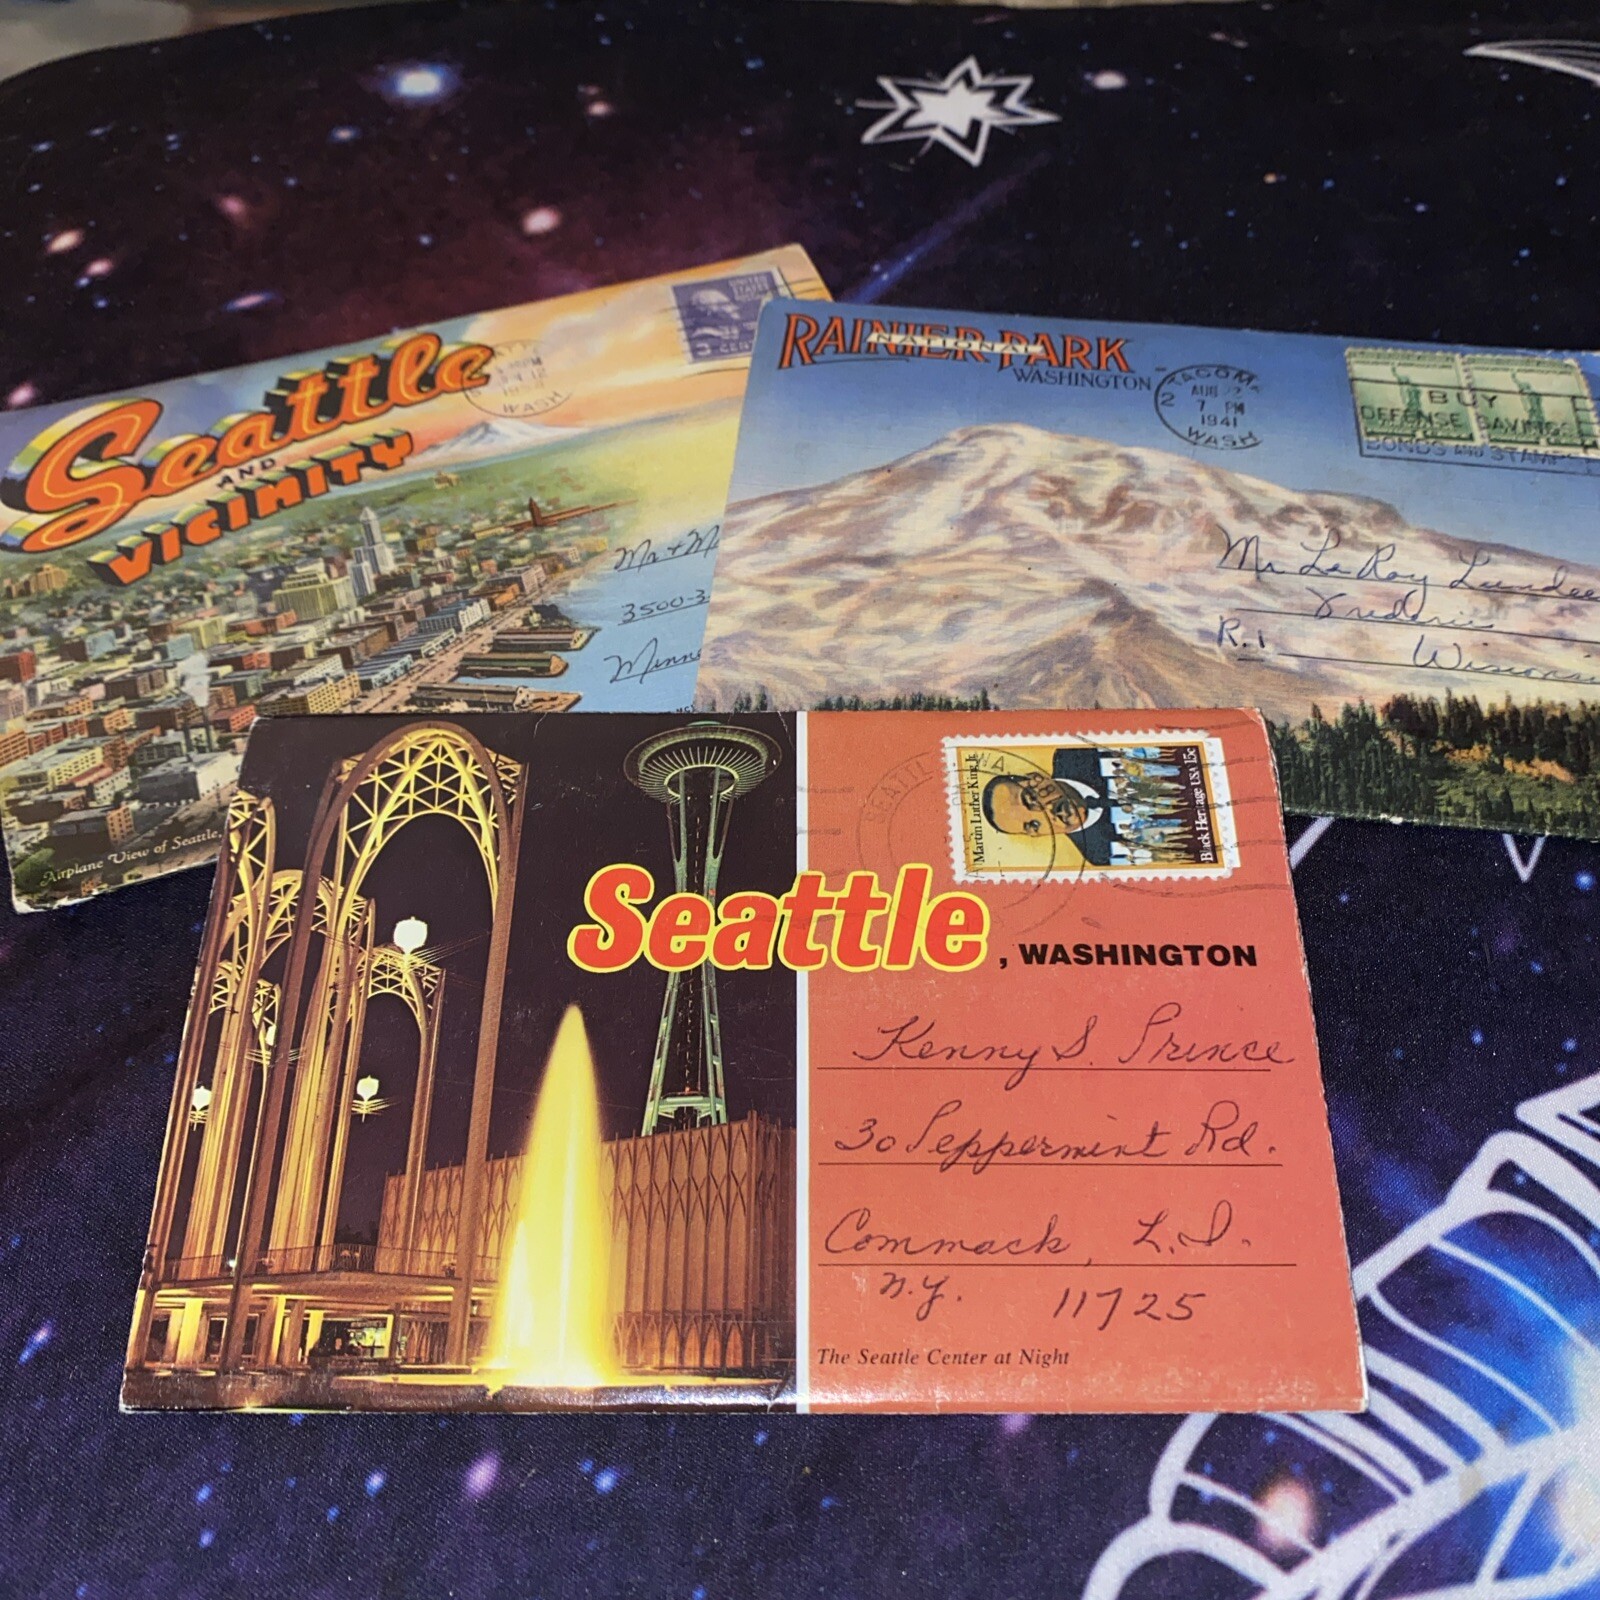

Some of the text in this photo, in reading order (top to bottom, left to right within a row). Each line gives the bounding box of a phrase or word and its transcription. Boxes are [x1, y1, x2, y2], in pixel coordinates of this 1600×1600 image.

[778, 313, 1135, 373] RAINIER PARK
[1012, 366, 1152, 392] WASHINGTON
[1225, 401, 1245, 415] PM
[1428, 389, 1498, 408] BUY
[1201, 413, 1238, 428] 1941
[1360, 404, 1463, 429] DEFENSE
[4, 331, 496, 553] Seattle
[214, 457, 277, 489] AND
[87, 428, 415, 585] VICINITY
[687, 524, 720, 558] M
[1188, 767, 1202, 786] USA
[969, 790, 982, 824] Luther
[971, 826, 985, 863] Martin
[1197, 832, 1214, 862] Black
[40, 859, 104, 887] Airplane
[108, 849, 150, 864] View
[154, 841, 169, 854] of
[1018, 943, 1259, 968] WASHINGTON
[851, 1014, 1043, 1091] Kenny
[834, 1118, 897, 1154] 30
[906, 1100, 1171, 1175] Peppermint
[1053, 1287, 1206, 1331] 11725
[817, 1347, 1070, 1370] The Seattle Center at Night
